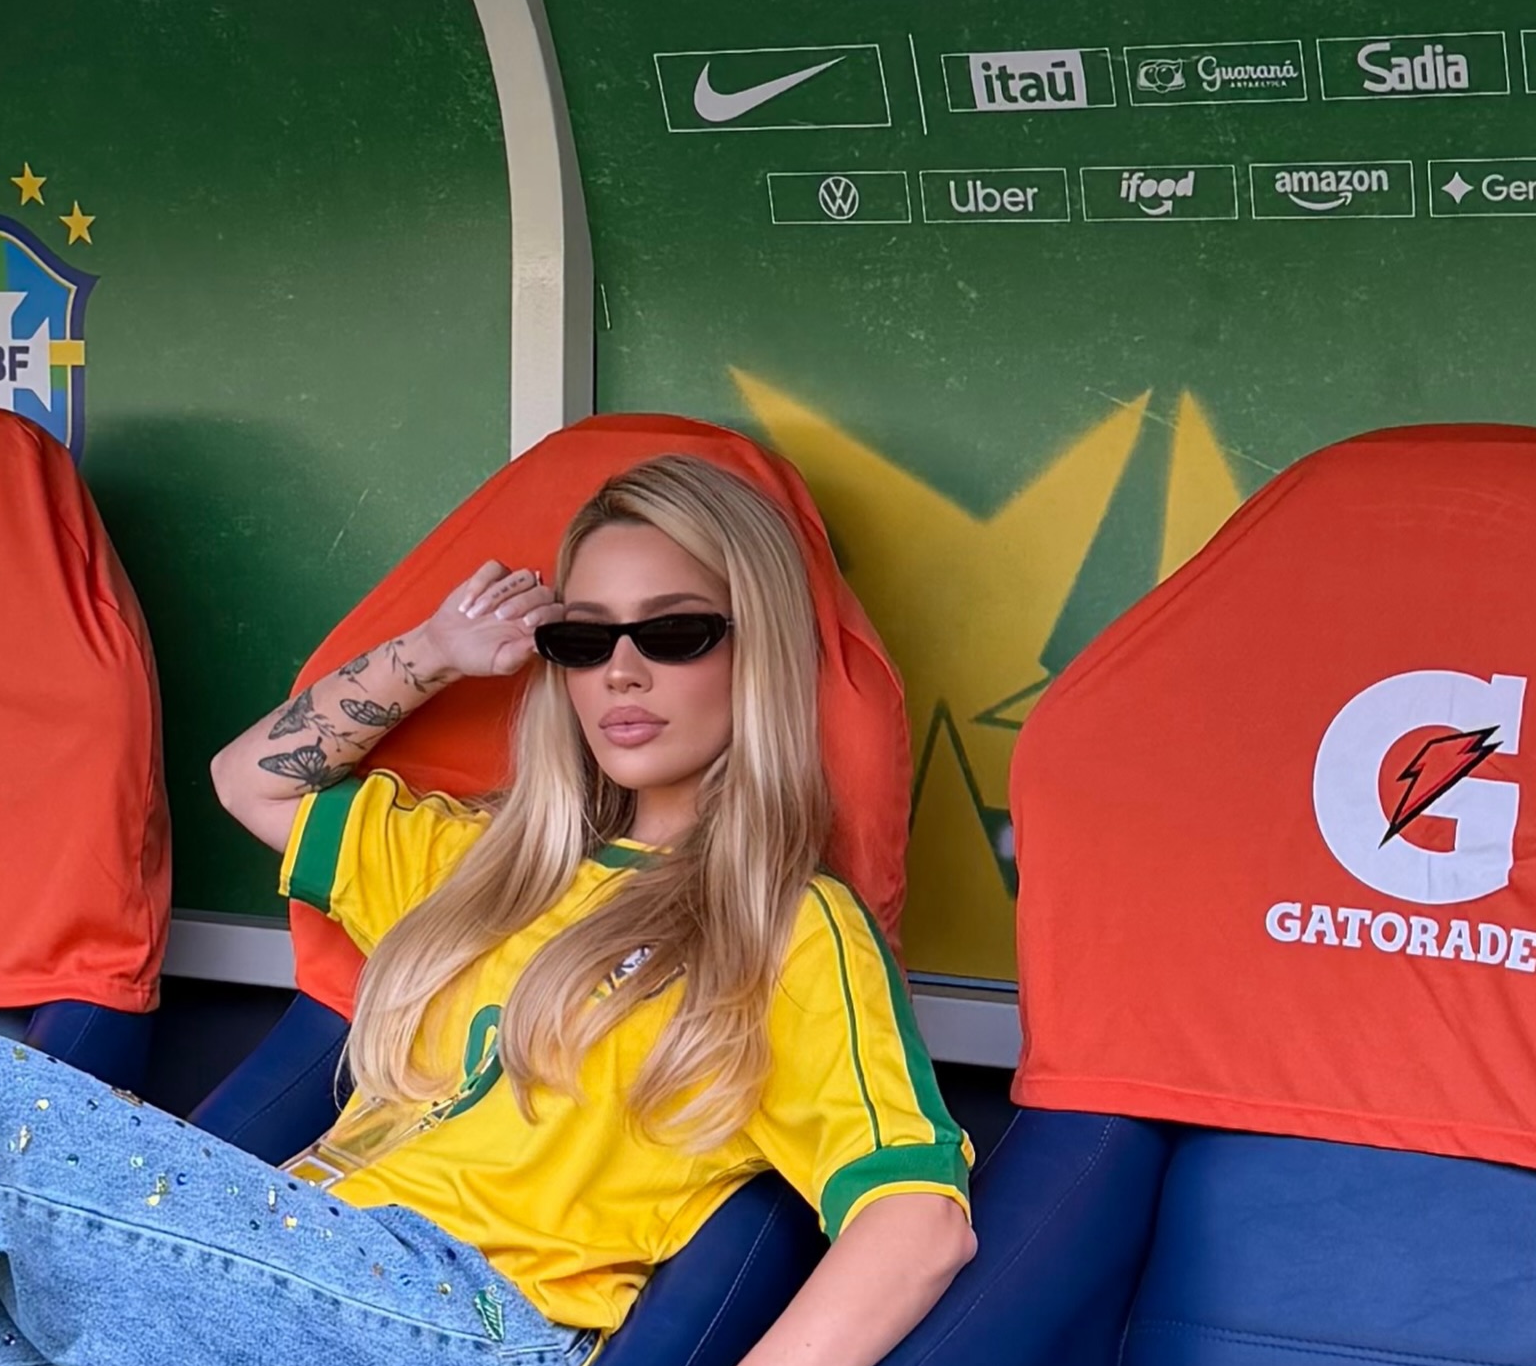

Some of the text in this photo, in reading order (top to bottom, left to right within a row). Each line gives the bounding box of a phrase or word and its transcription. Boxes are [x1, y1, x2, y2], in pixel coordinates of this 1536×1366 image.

[1197, 56, 1300, 92] Guaraná
[1357, 42, 1469, 93] Sadia
[948, 180, 1039, 213] Uber
[1274, 168, 1389, 194] amazon
[1312, 669, 1528, 905] G
[1265, 901, 1536, 973] GATORADE
